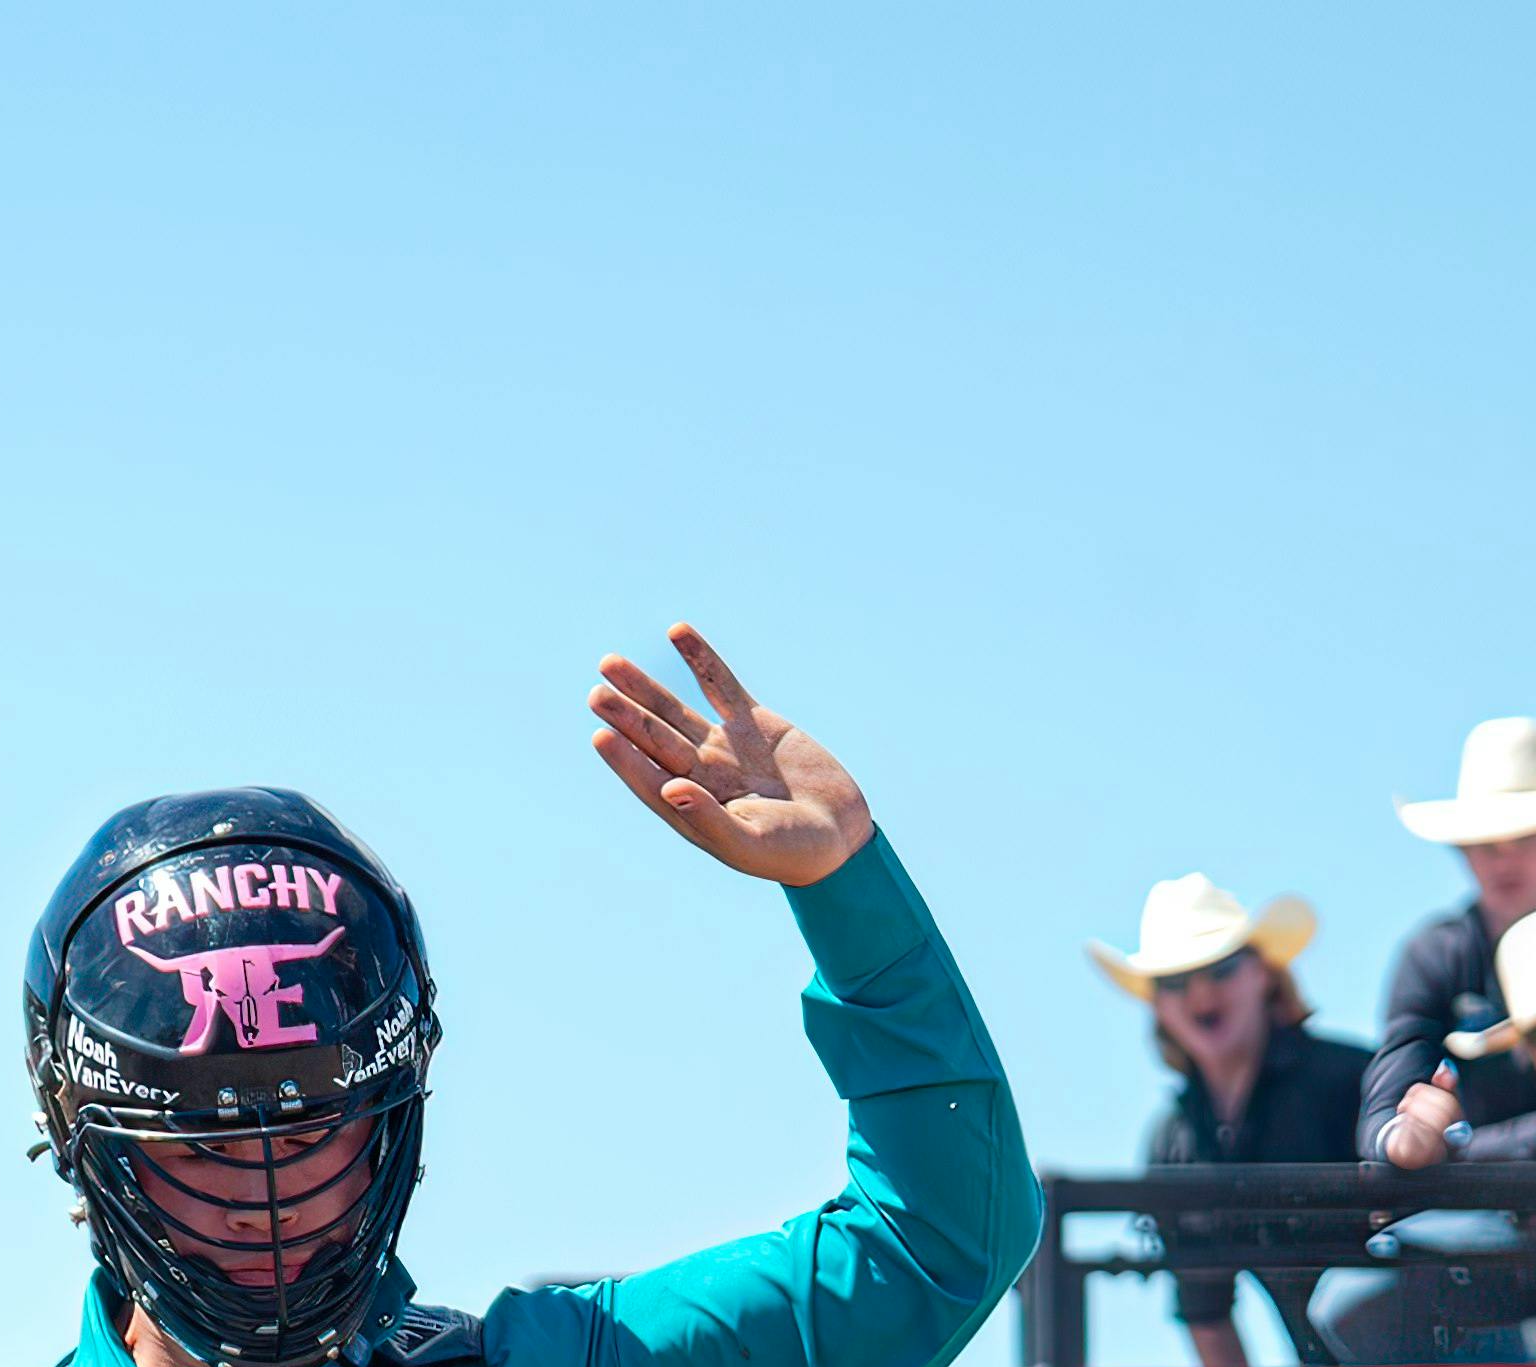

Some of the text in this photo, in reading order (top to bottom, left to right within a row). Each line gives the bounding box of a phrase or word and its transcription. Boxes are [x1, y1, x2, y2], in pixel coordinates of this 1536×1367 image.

[115, 863, 342, 946] RANCHY
[67, 1013, 118, 1069] Noah
[67, 1049, 180, 1104] VanEvery
